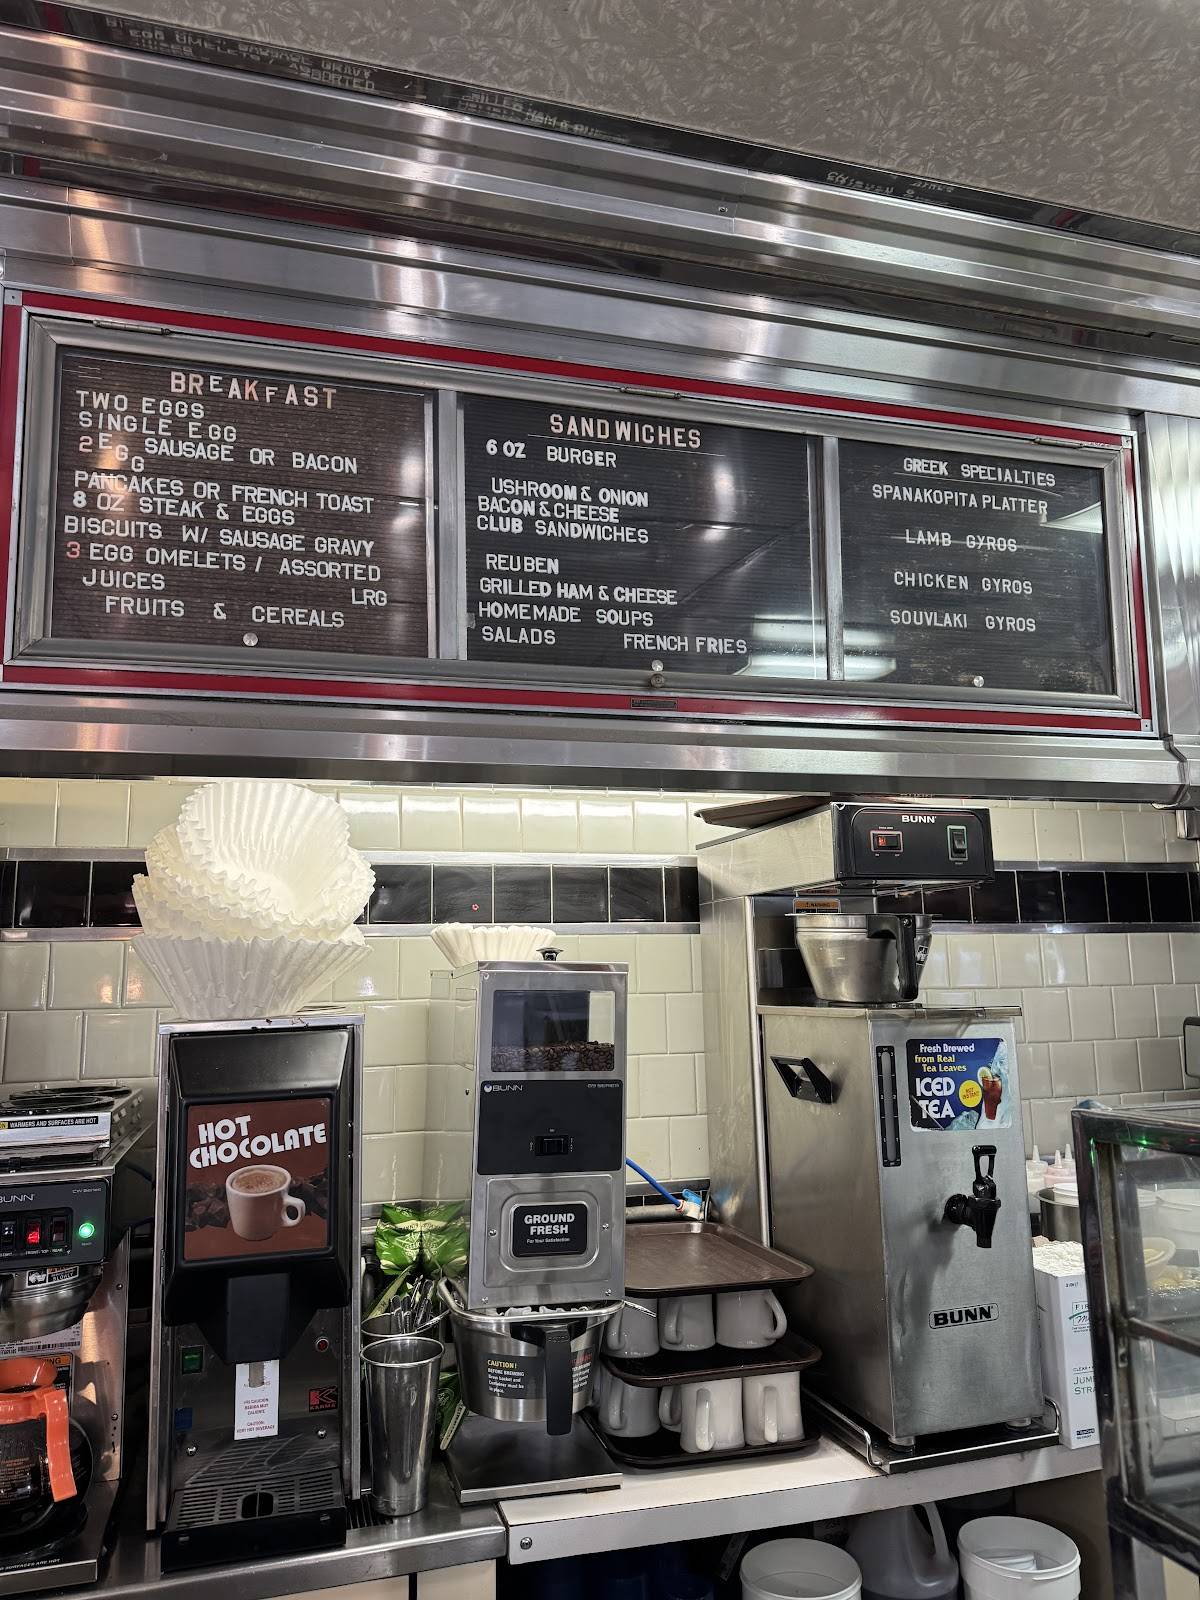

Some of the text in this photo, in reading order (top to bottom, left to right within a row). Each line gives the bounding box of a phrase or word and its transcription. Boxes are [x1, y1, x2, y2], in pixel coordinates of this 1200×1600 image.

[170, 371, 337, 410] BREAKFAST
[75, 390, 205, 419] TWO EGGS
[78, 412, 238, 442] SINGLE EGG
[550, 413, 701, 449] SANDWICHES
[79, 436, 92, 453] 2
[144, 438, 234, 462] SAUSAGE
[249, 448, 275, 466] OR
[292, 453, 358, 475] BACON
[486, 438, 617, 468] 6 OZ BURGER
[903, 458, 1056, 487] GREEK SPECIALTIES
[74, 470, 374, 514] PANCAKES OR FRENCH TOAST
[491, 477, 648, 507] USHROOM & ONION
[872, 484, 1048, 515] SPANAKOPITA PLATTER
[72, 490, 295, 526] 8 OZ STEAK & EGGS
[477, 496, 620, 523] BACON & CHEESE
[64, 515, 374, 558] BISCUITS W/ SAUSAGE GRAVY
[477, 515, 648, 544] CLUB SANDWICHES
[905, 529, 1017, 552] LAMB GYROS
[66, 542, 81, 559] 3
[89, 543, 134, 561] EGG
[145, 547, 246, 571] OMELETS
[279, 558, 381, 581] ASSORTED
[485, 554, 559, 574] REUBEN
[82, 569, 166, 590] JUICES
[479, 577, 678, 605] GRILLED HAM & CHEESE
[893, 571, 1033, 594] CHICKEN GYROS
[351, 587, 388, 607] LRG
[106, 595, 344, 628] FRUITS & CEREALS
[478, 602, 654, 627] HOMEMADE SOUPS
[890, 610, 1036, 632] SOUVLAKI GYROS
[481, 627, 747, 654] SALADS FRENCH FRIES
[901, 815, 936, 824] BUNN
[915, 1055, 934, 1063] from
[920, 1043, 975, 1053] Fresh Brewed
[922, 1064, 967, 1072] Tea Leaves
[492, 1084, 523, 1092] BUNN
[916, 1077, 956, 1096] ICED
[918, 1100, 956, 1119] TEA
[198, 1115, 251, 1144] HOT
[189, 1123, 327, 1168] CHOCOLATE
[524, 1213, 575, 1225] GROUND
[530, 1224, 569, 1236] FRESH
[934, 1306, 991, 1326] BUNN
[1074, 1376, 1096, 1384] JUM
